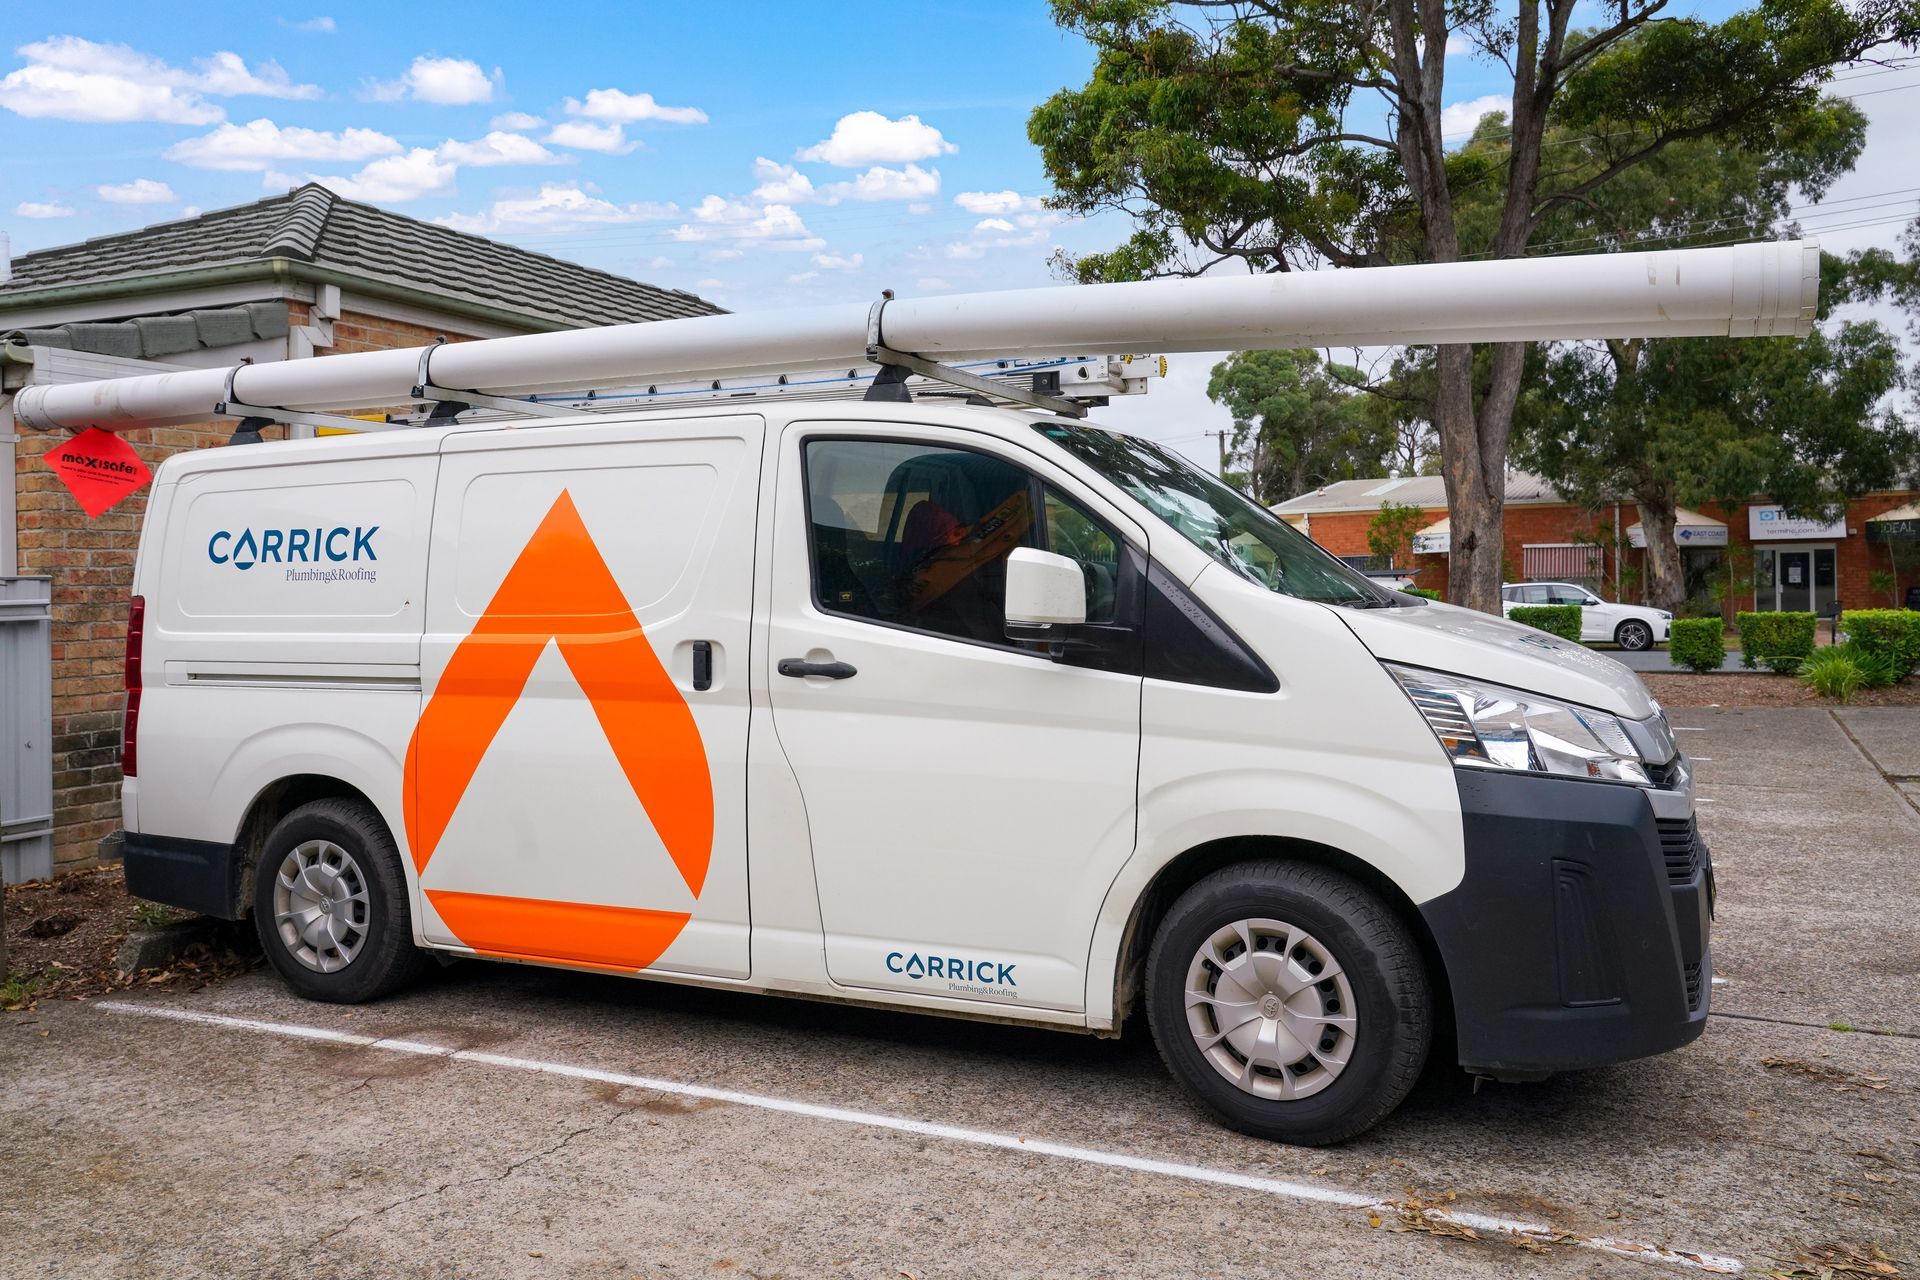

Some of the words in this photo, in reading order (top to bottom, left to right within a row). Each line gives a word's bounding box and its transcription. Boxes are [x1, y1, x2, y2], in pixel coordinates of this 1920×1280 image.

[208, 526, 380, 571] CARRICK
[286, 567, 377, 584] Plumbing&Roofing
[886, 952, 1017, 987] CARRICK
[948, 982, 1018, 999] Plumbing&Roofing
